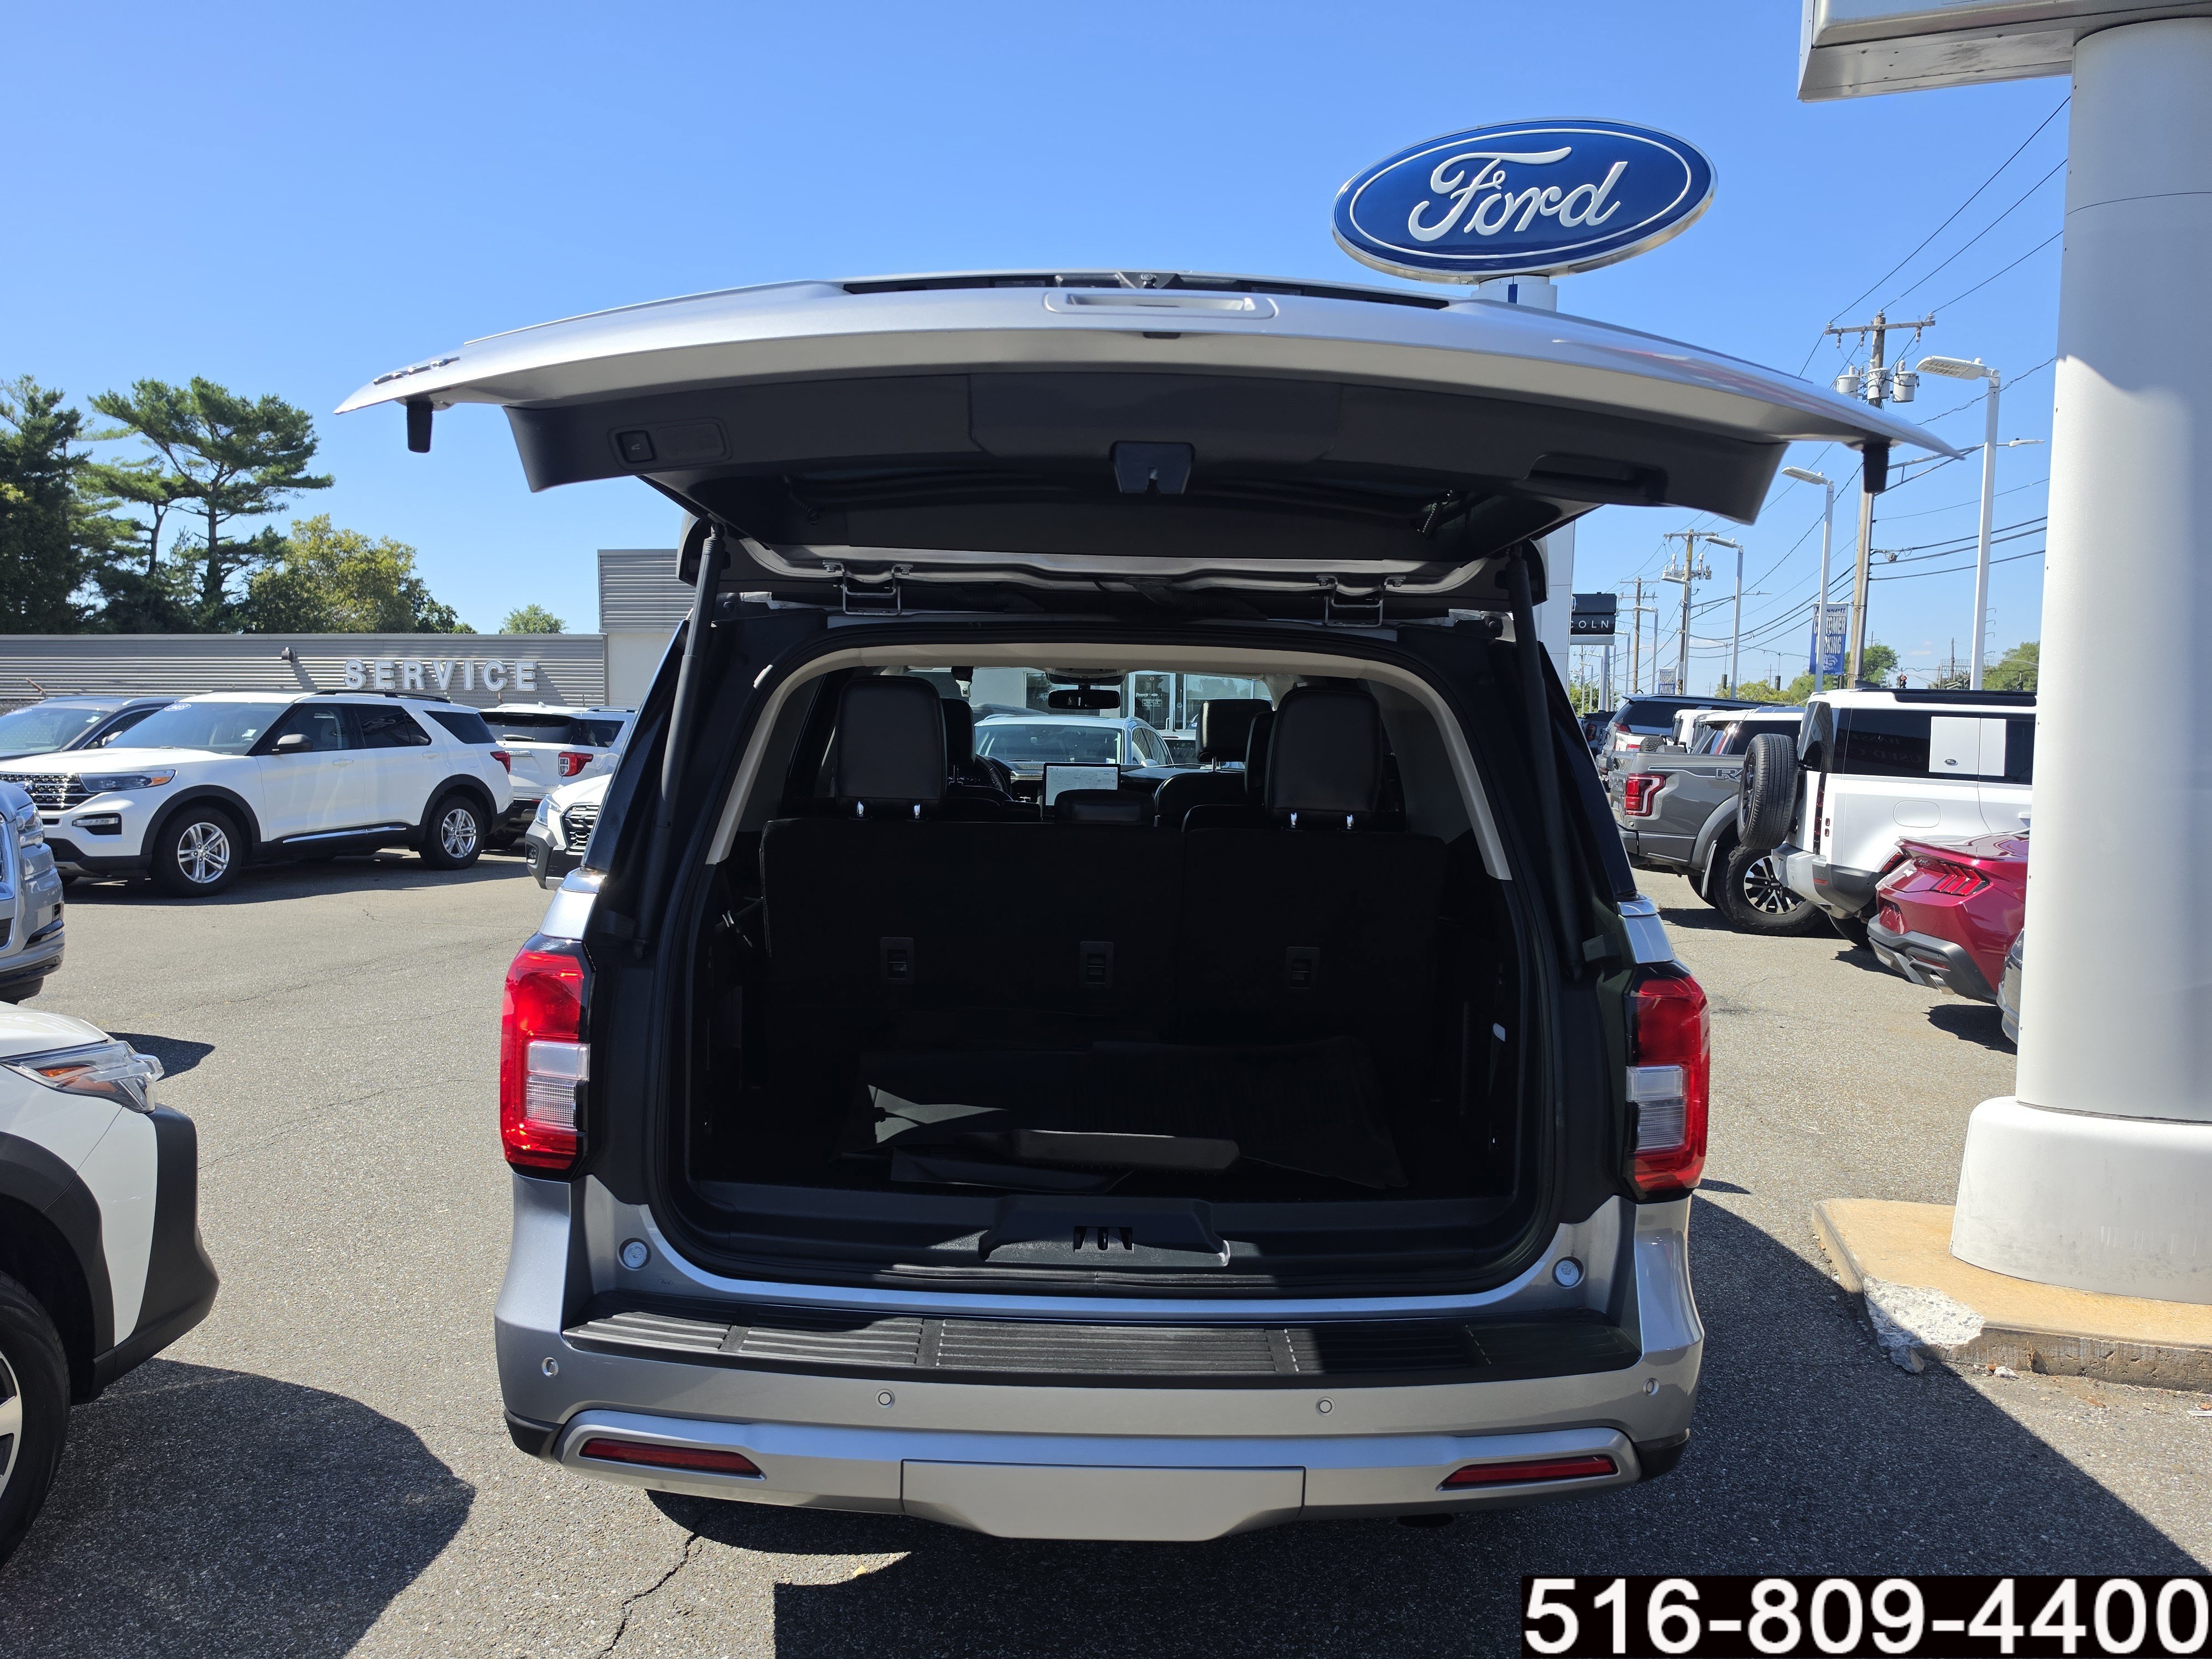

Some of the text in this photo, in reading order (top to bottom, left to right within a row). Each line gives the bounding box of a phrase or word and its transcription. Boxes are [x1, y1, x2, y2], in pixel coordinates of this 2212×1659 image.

[1408, 147, 1628, 242] Ford
[1813, 616, 1846, 635] CTOMER
[344, 659, 538, 691] SERVICE
